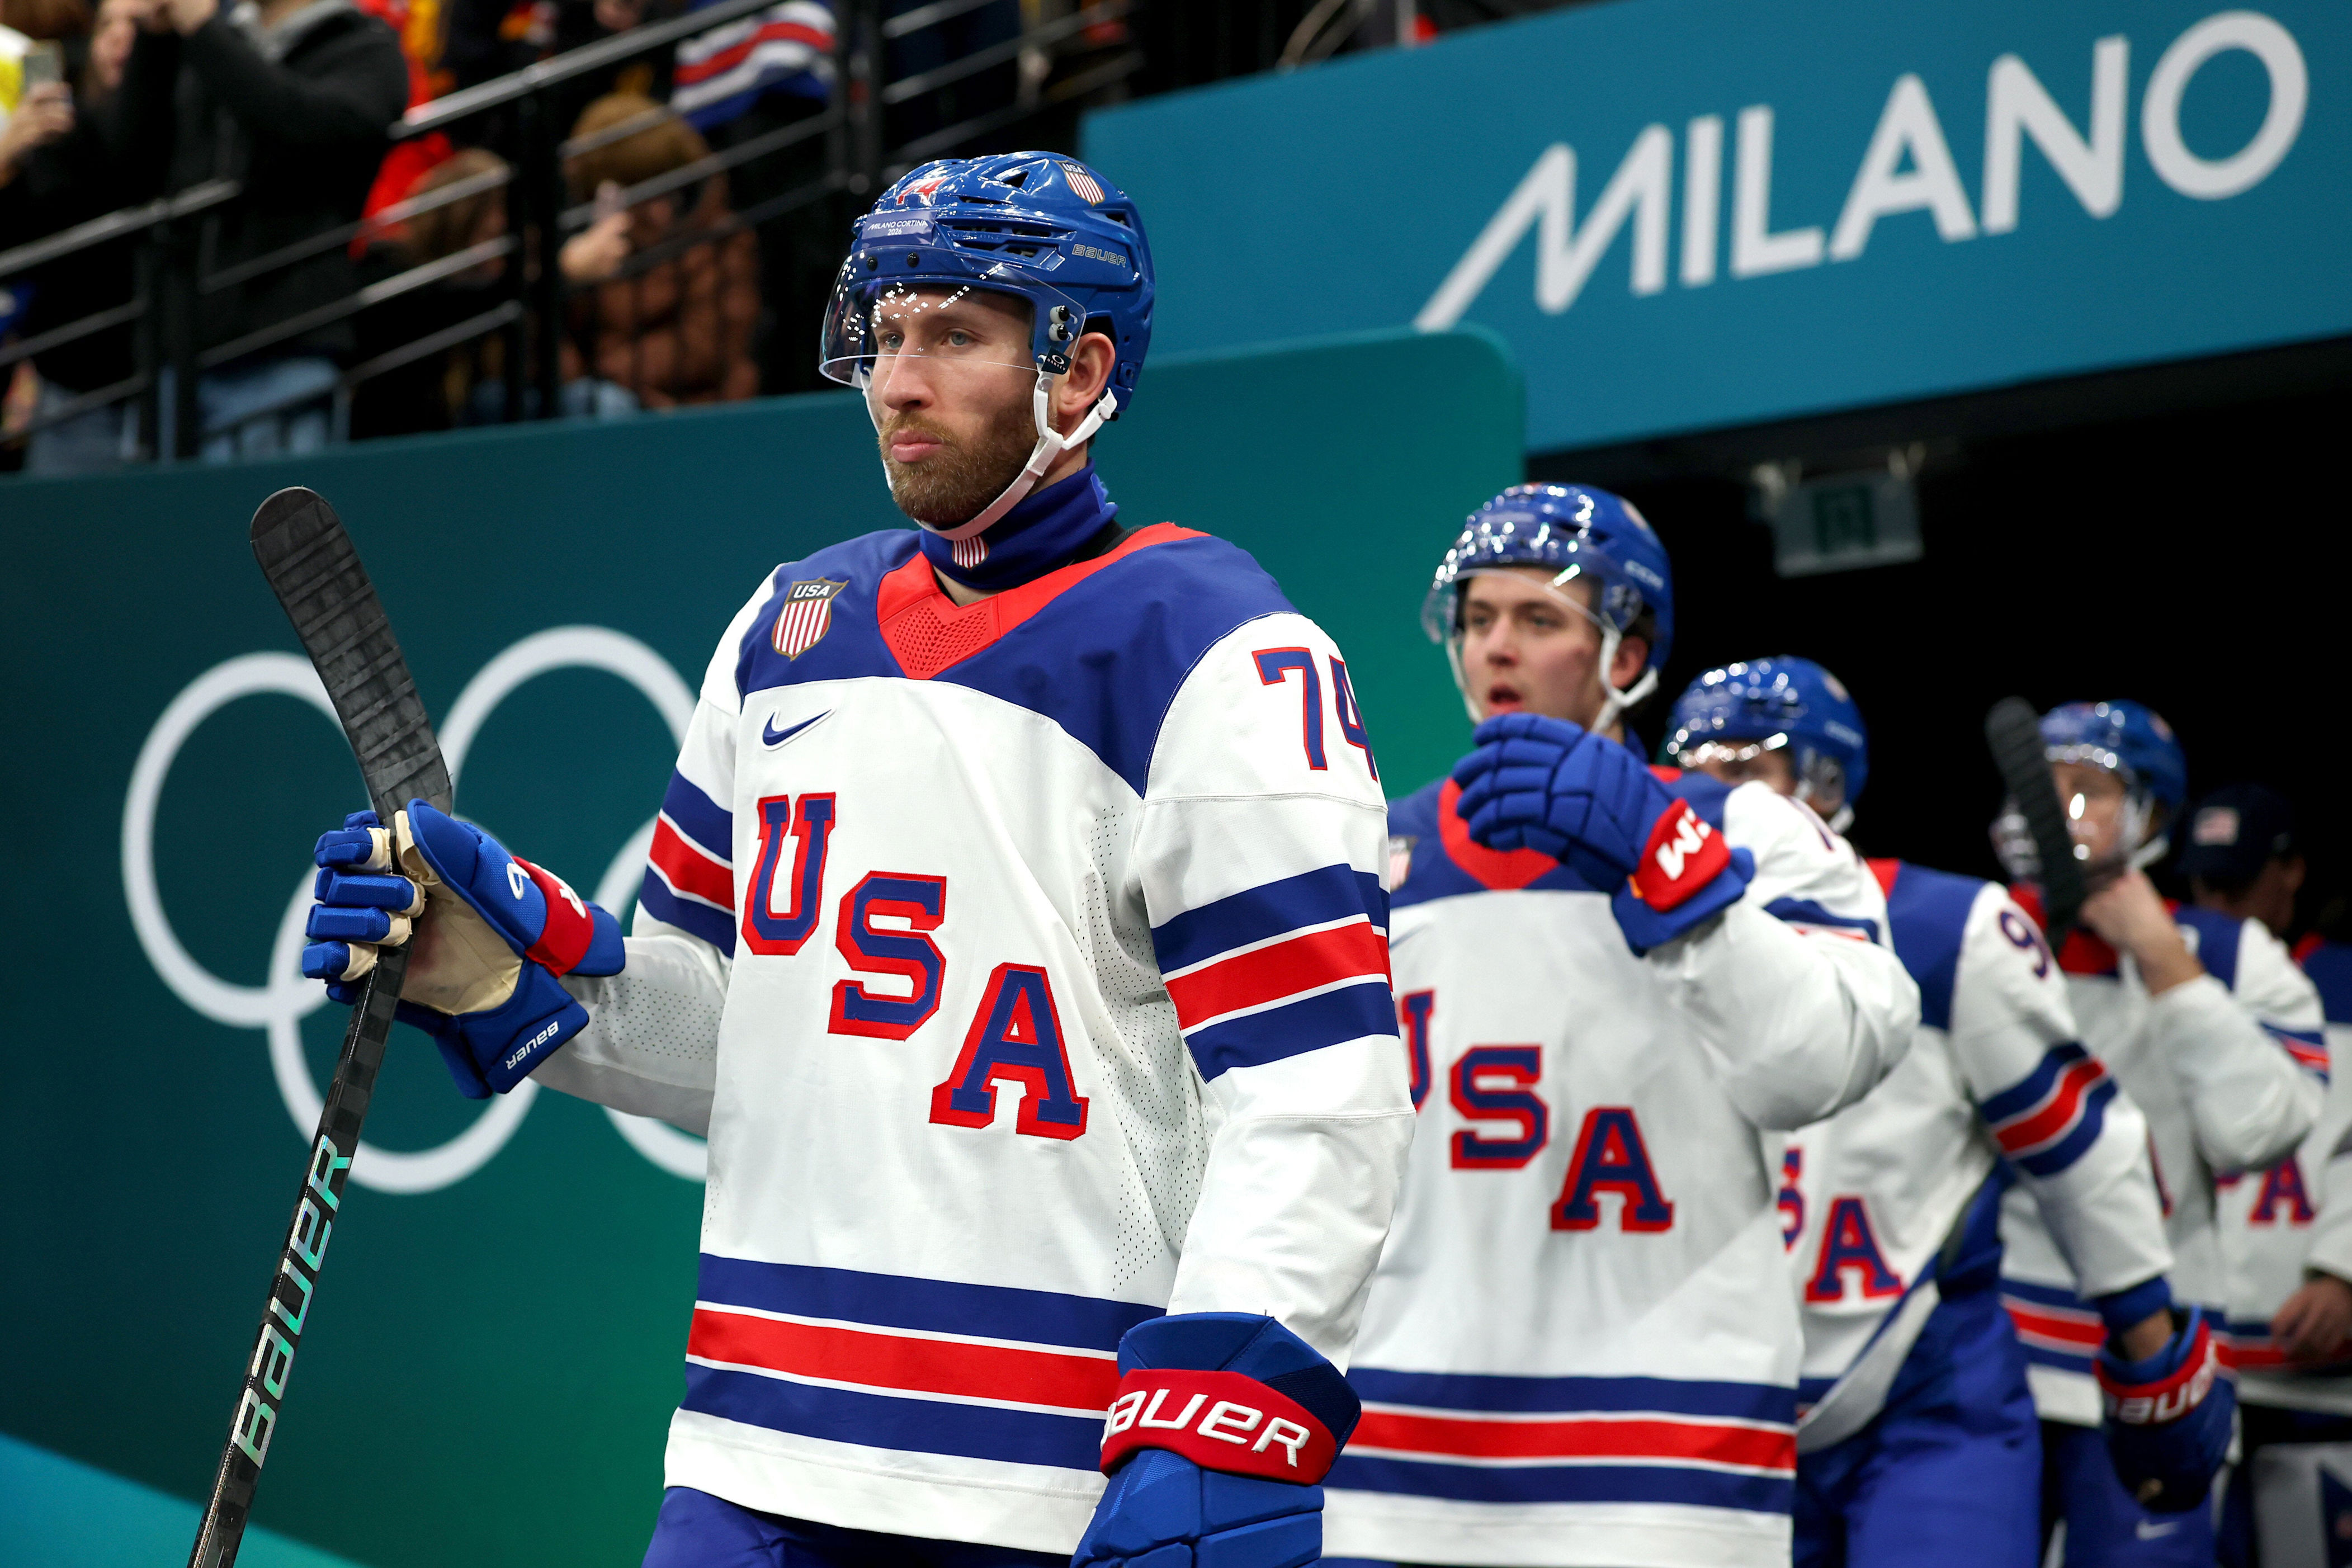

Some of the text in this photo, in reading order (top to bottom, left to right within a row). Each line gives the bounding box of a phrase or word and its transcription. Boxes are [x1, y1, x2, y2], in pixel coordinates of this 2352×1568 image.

[1062, 163, 1085, 174] USA
[1413, 10, 2308, 332] MILANO
[867, 221, 896, 230] MILANO
[794, 585, 830, 598] USA
[1251, 646, 1378, 783] 74
[741, 791, 1090, 1141] USA
